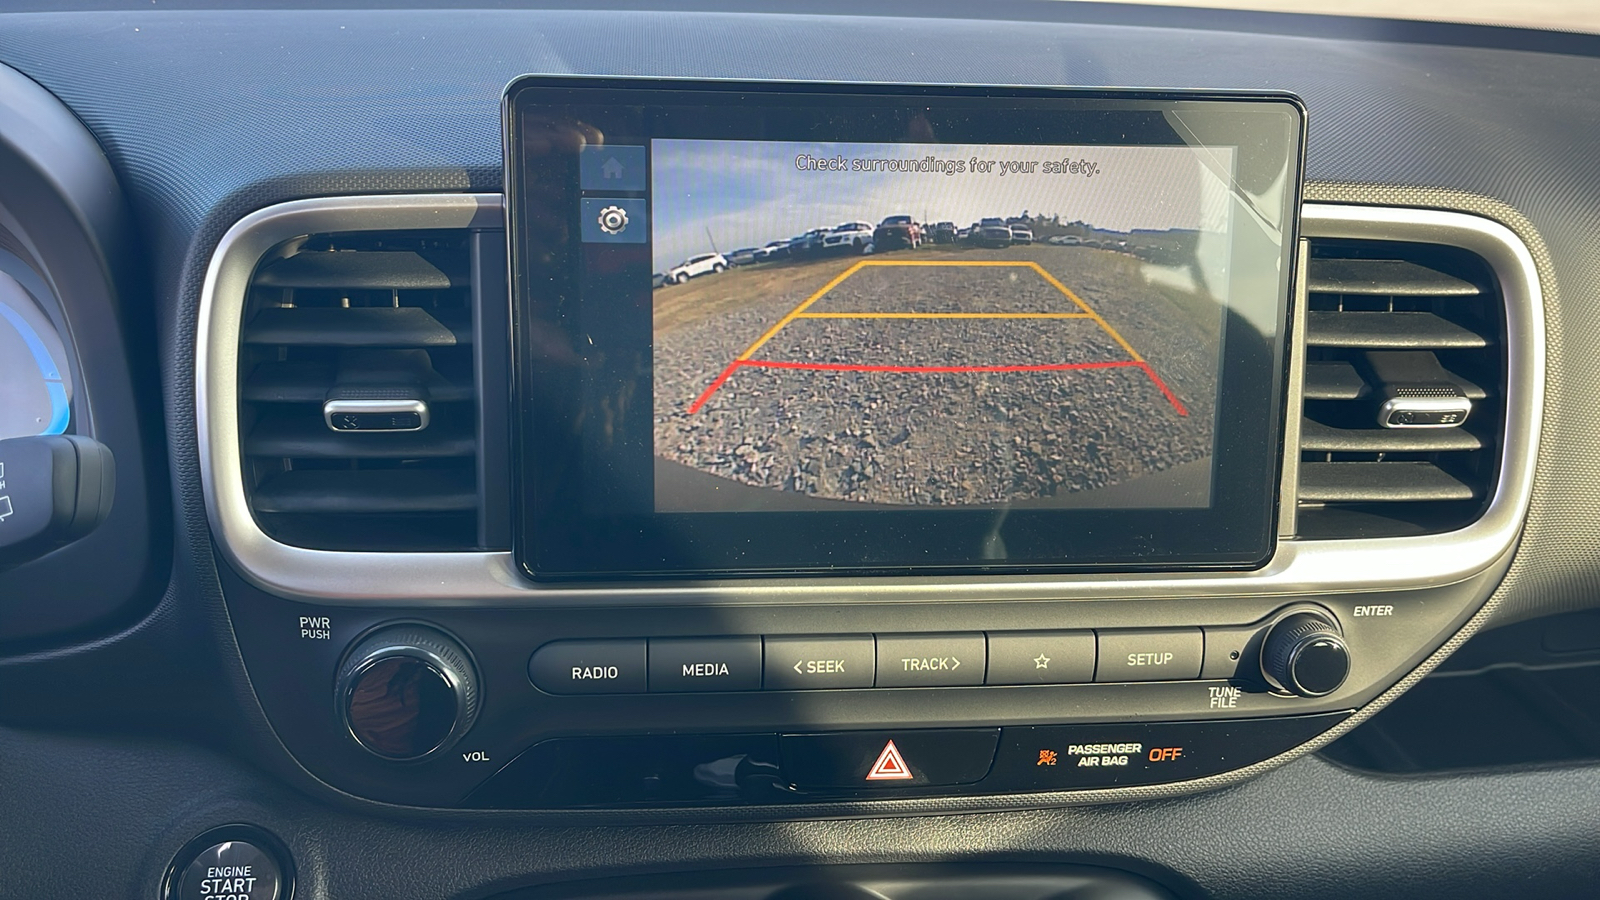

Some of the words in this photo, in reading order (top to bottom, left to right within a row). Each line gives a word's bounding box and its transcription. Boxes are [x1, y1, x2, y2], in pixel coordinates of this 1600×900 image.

[795, 153, 848, 171] Check
[851, 156, 966, 176] surroundings
[969, 157, 996, 173] for
[999, 160, 1039, 177] your
[1042, 158, 1101, 178] safety.
[1353, 605, 1394, 617] ENTER
[299, 617, 331, 629] PWR
[301, 629, 331, 640] PUSH
[1126, 652, 1174, 667] SETUP
[571, 666, 619, 680] RADIO
[682, 663, 729, 677] MEDIA
[1208, 686, 1242, 698] TUNE
[1209, 698, 1238, 709] FILE
[1067, 743, 1143, 755] PASSENGER
[1148, 747, 1184, 762] OFF
[462, 751, 490, 762] VOL
[1077, 756, 1100, 767] AIR
[1101, 755, 1129, 766] BAG
[207, 865, 252, 878] ENGINE
[200, 877, 257, 894] START
